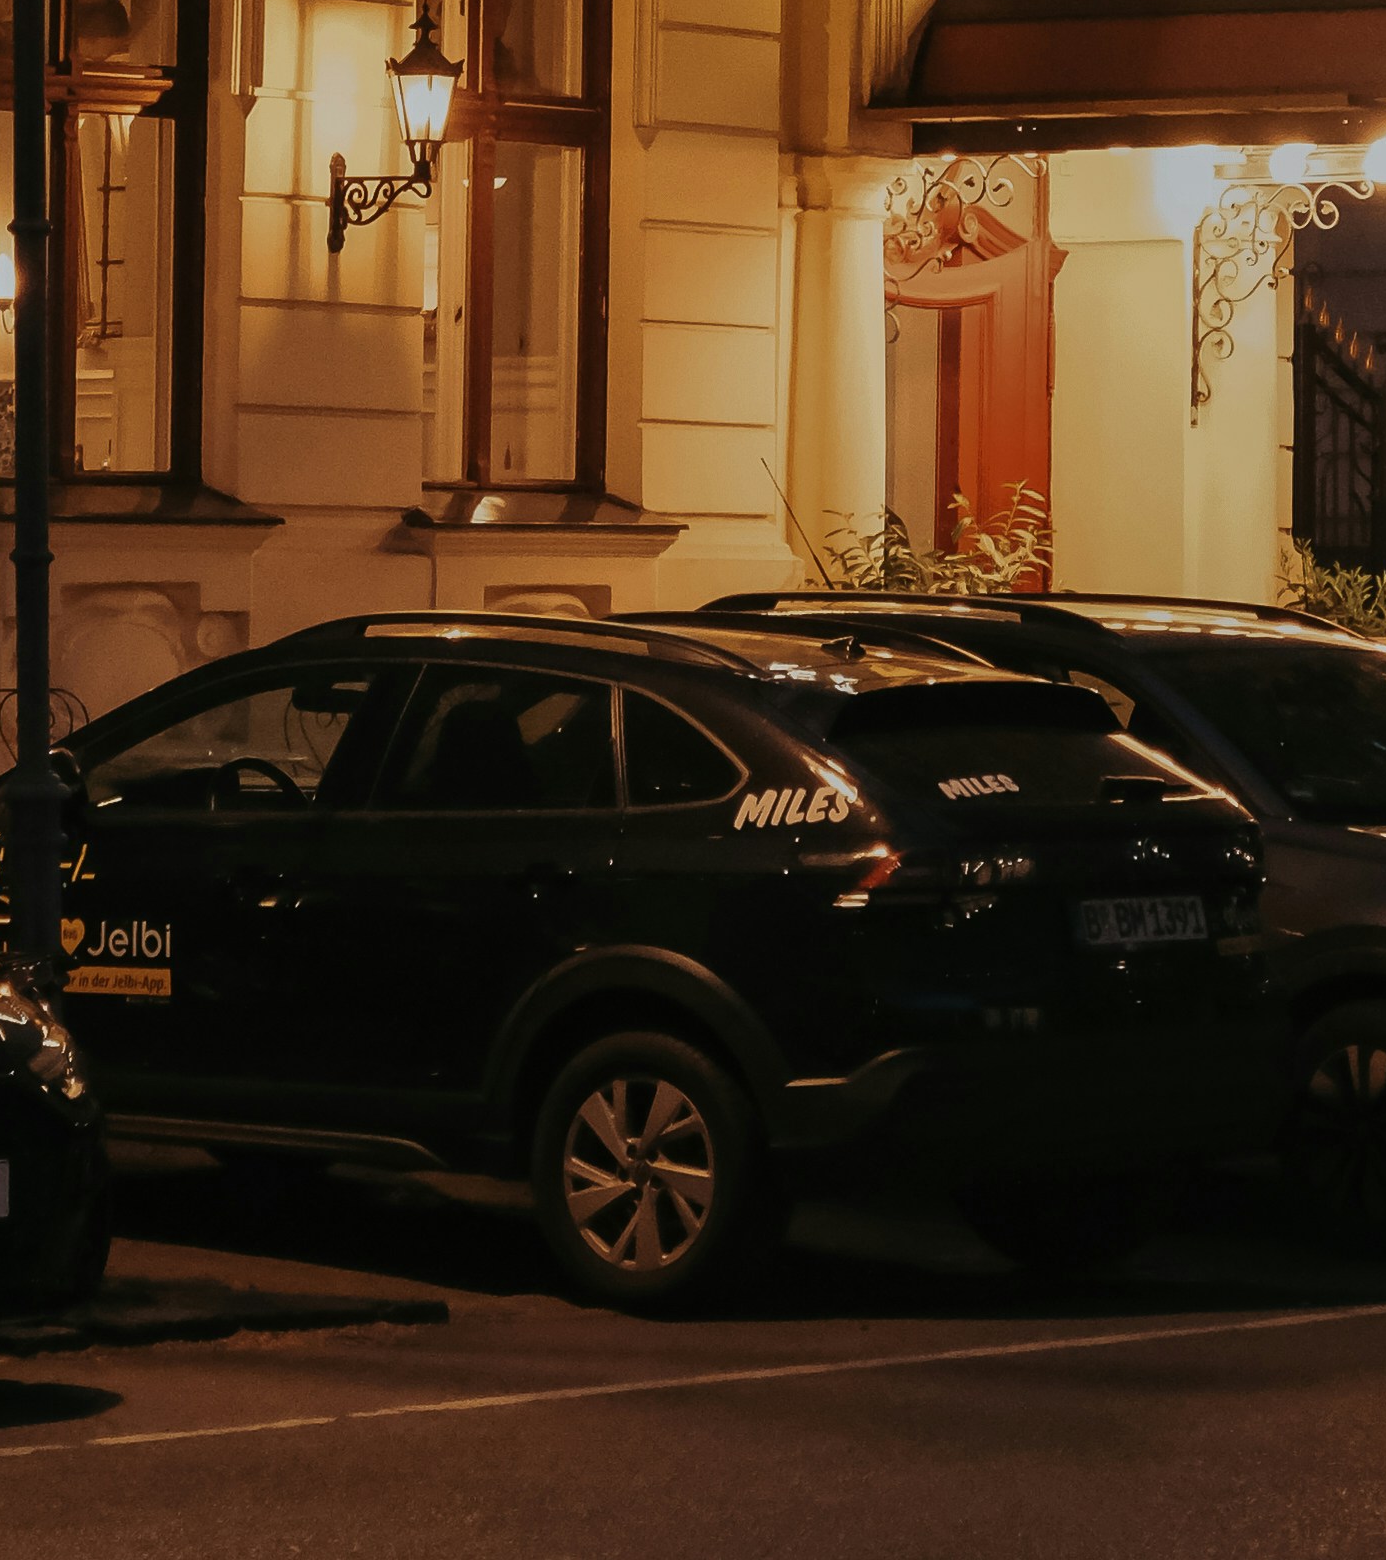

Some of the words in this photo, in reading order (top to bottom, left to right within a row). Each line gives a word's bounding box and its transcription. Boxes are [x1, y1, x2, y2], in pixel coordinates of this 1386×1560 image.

[937, 773, 1021, 800] MILES
[733, 785, 856, 831] MILES
[86, 920, 171, 959] Jelbi
[78, 972, 89, 987] in
[92, 973, 110, 989] der
[112, 974, 168, 993] Jelbi-App.
